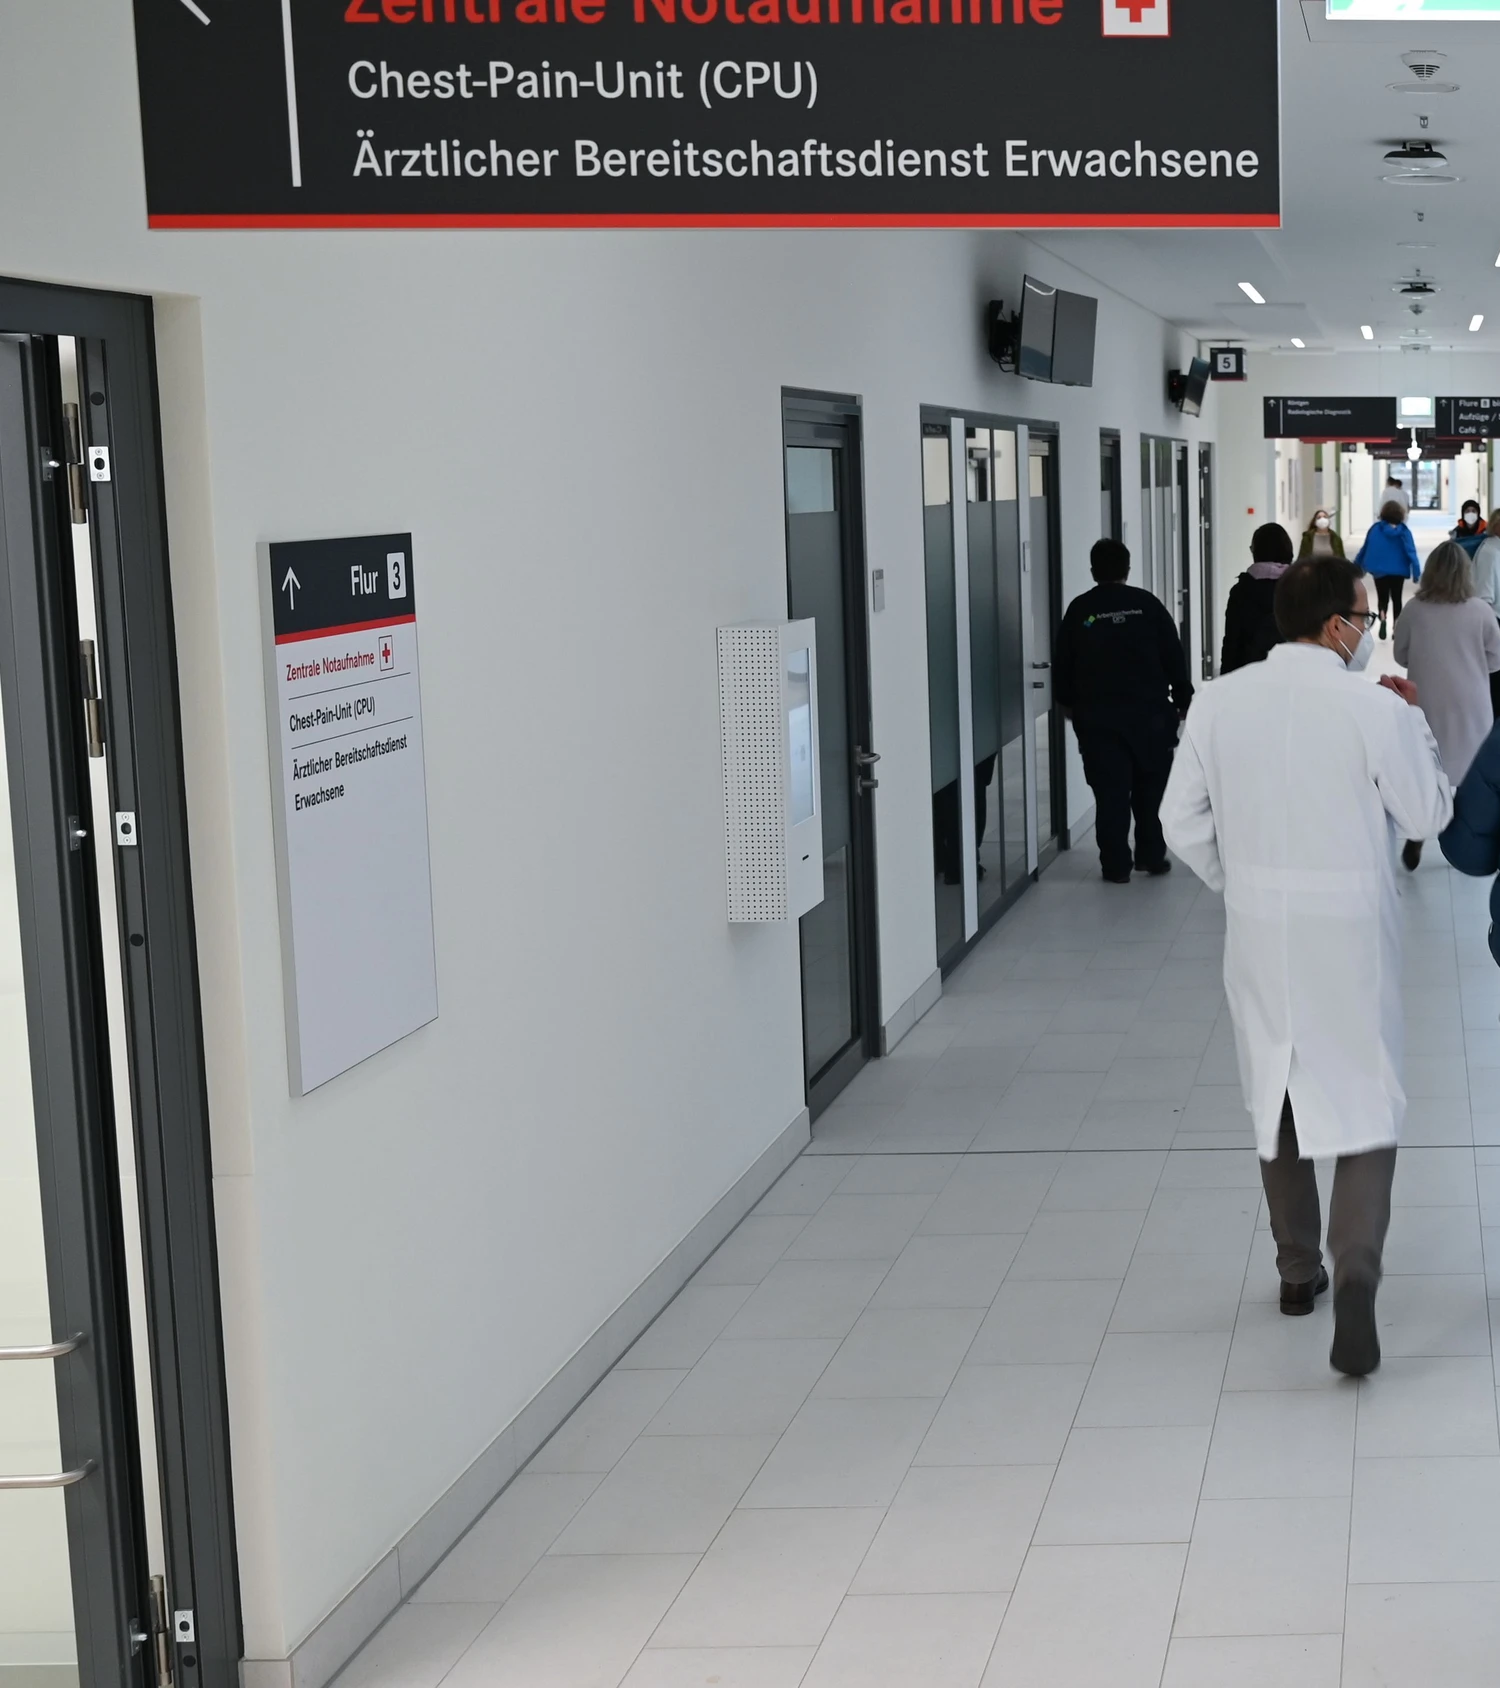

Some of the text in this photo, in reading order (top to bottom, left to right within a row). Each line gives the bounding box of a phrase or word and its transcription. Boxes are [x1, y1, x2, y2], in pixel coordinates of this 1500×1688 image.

[348, 60, 818, 109] Chest-Pain-Unit (CPU)
[352, 129, 1260, 178] Ärztlicher Bereitschaftsdienst Erwachsene
[1222, 357, 1231, 369] 5
[1459, 399, 1478, 407] Flure
[1459, 412, 1490, 422] Aufzüge
[1458, 426, 1476, 435] Café
[350, 561, 401, 596] Flur 3
[286, 651, 375, 681] Zentrale Notaufnahme
[289, 696, 376, 732] Chest-Pain-Unit (CPU)
[293, 734, 408, 781] Ärztlicher Bereitschaftsdienst
[295, 782, 345, 811] Erwachsene
